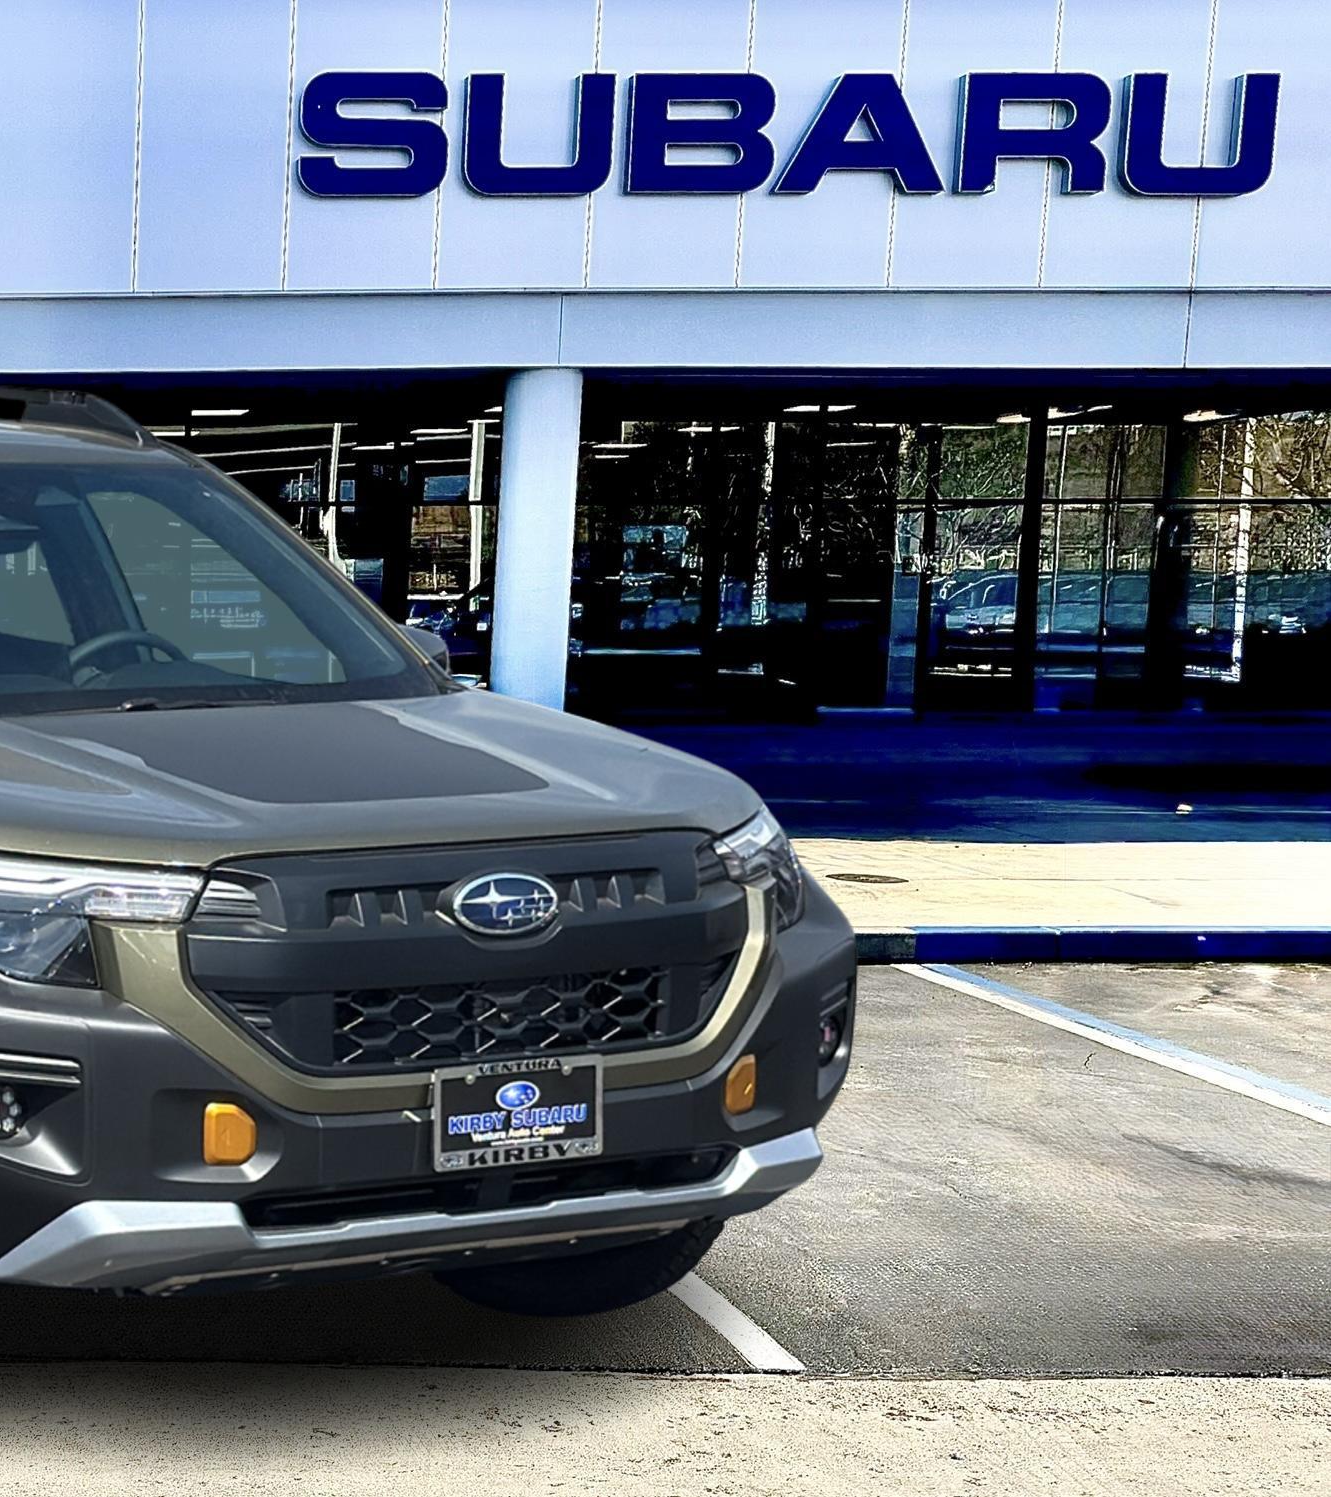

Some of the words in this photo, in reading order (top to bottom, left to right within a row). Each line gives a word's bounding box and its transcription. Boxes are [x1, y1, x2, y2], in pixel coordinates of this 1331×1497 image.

[297, 71, 1281, 198] SUBARU
[478, 1059, 562, 1075] VENTURA
[448, 1112, 507, 1134] KIRBY
[511, 1104, 587, 1127] SUBARU
[468, 1141, 571, 1167] KIRBY
